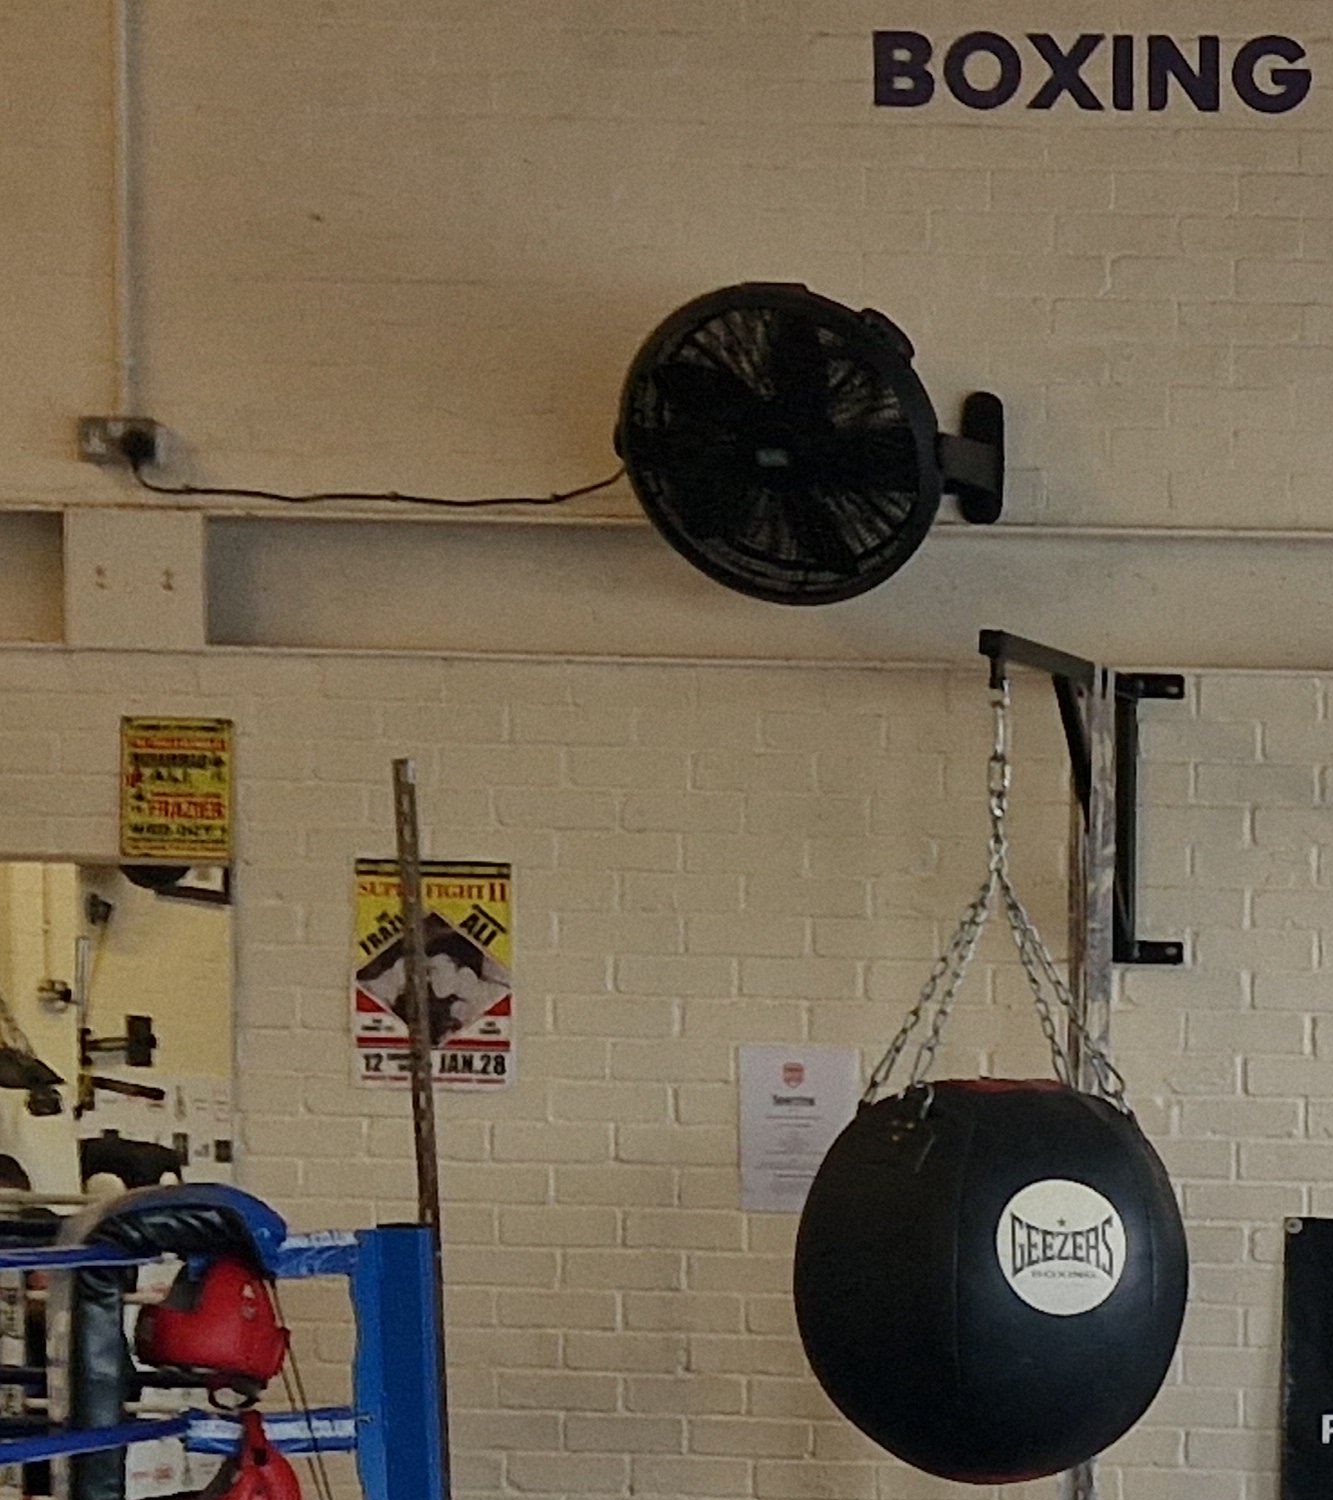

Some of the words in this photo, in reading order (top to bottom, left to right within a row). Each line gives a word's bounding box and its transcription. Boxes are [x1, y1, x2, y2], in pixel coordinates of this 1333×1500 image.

[873, 31, 1312, 114] BOXING
[459, 912, 498, 947] ALI
[363, 1052, 384, 1073] 12
[1010, 1211, 1113, 1280] GEEZERS
[1031, 1269, 1098, 1279] BOXING
